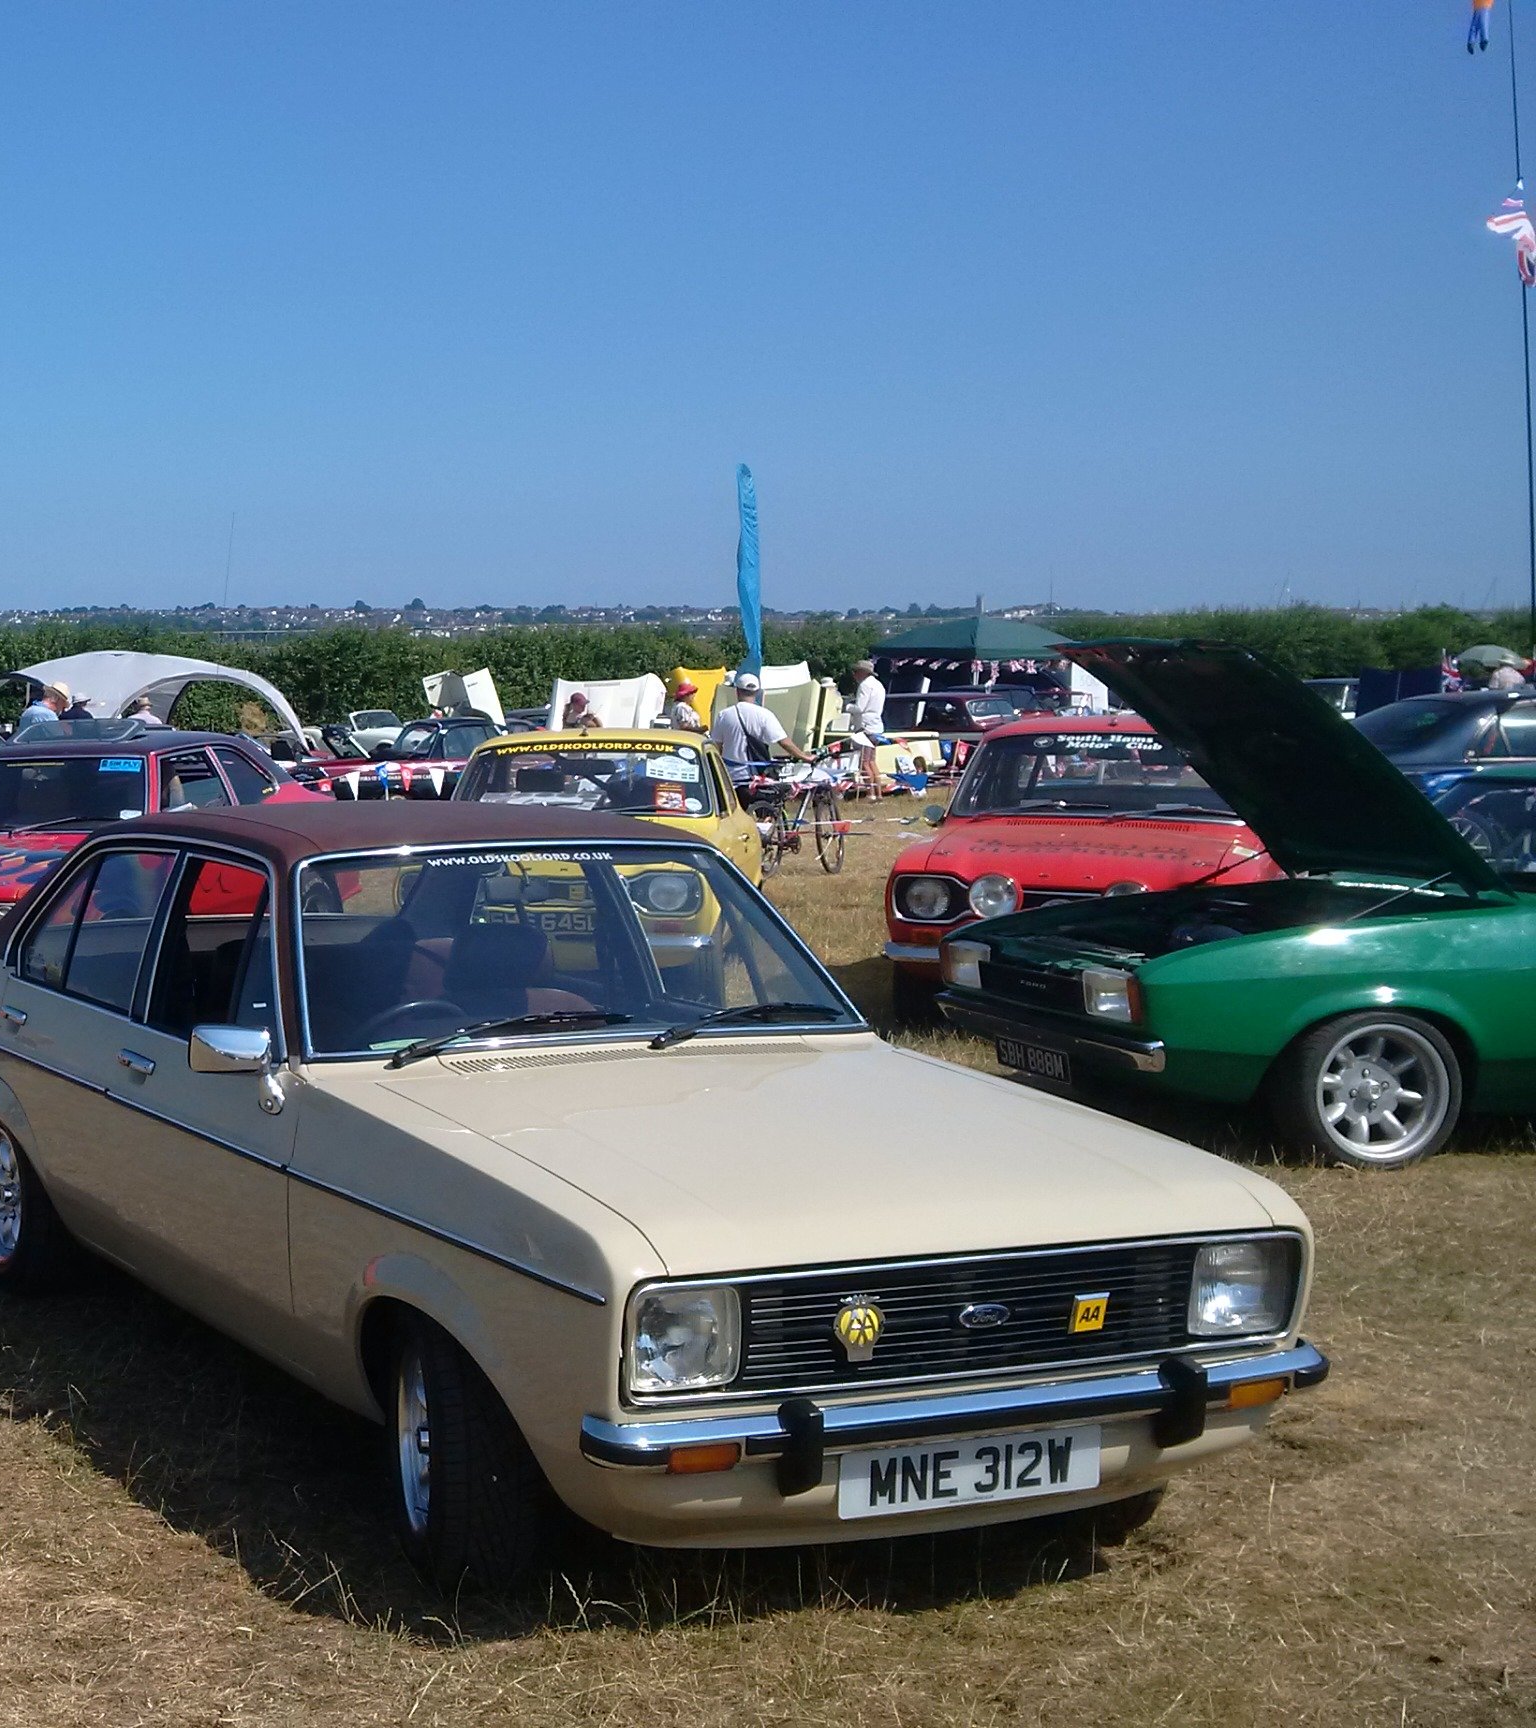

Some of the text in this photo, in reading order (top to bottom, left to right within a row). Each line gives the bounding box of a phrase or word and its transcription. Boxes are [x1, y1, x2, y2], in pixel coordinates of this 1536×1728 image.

[1065, 741, 1163, 751] Motor Club
[1109, 735, 1154, 743] Hams
[497, 742, 675, 756] WWW.OLDSKOOLFORD.CO.UK
[427, 852, 613, 867] WWW.OLDSKOOLFORD.CO.UK
[1079, 1305, 1101, 1323] AA
[869, 1437, 1073, 1507] MNE 312W
